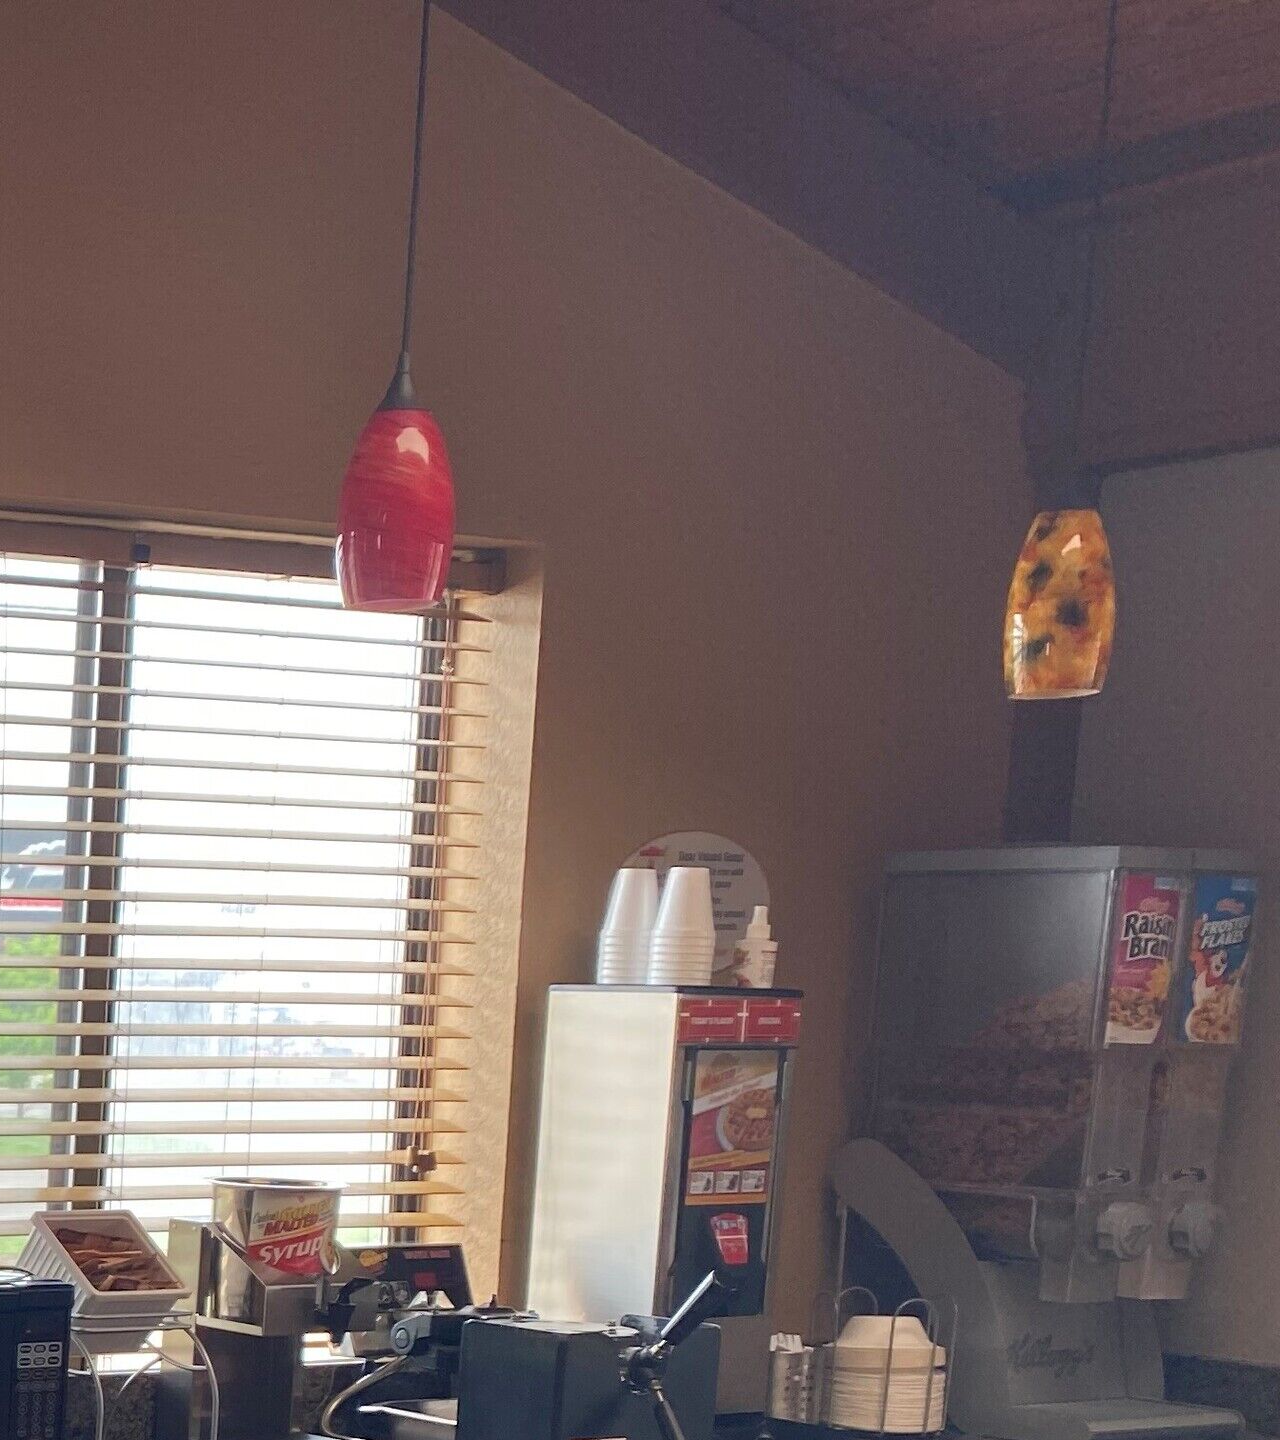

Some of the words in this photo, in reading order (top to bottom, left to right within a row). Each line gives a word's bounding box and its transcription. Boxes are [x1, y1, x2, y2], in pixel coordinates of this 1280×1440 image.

[1124, 912, 1177, 940] Raisin
[1129, 936, 1170, 960] Bran
[259, 1236, 323, 1266] Syrup
